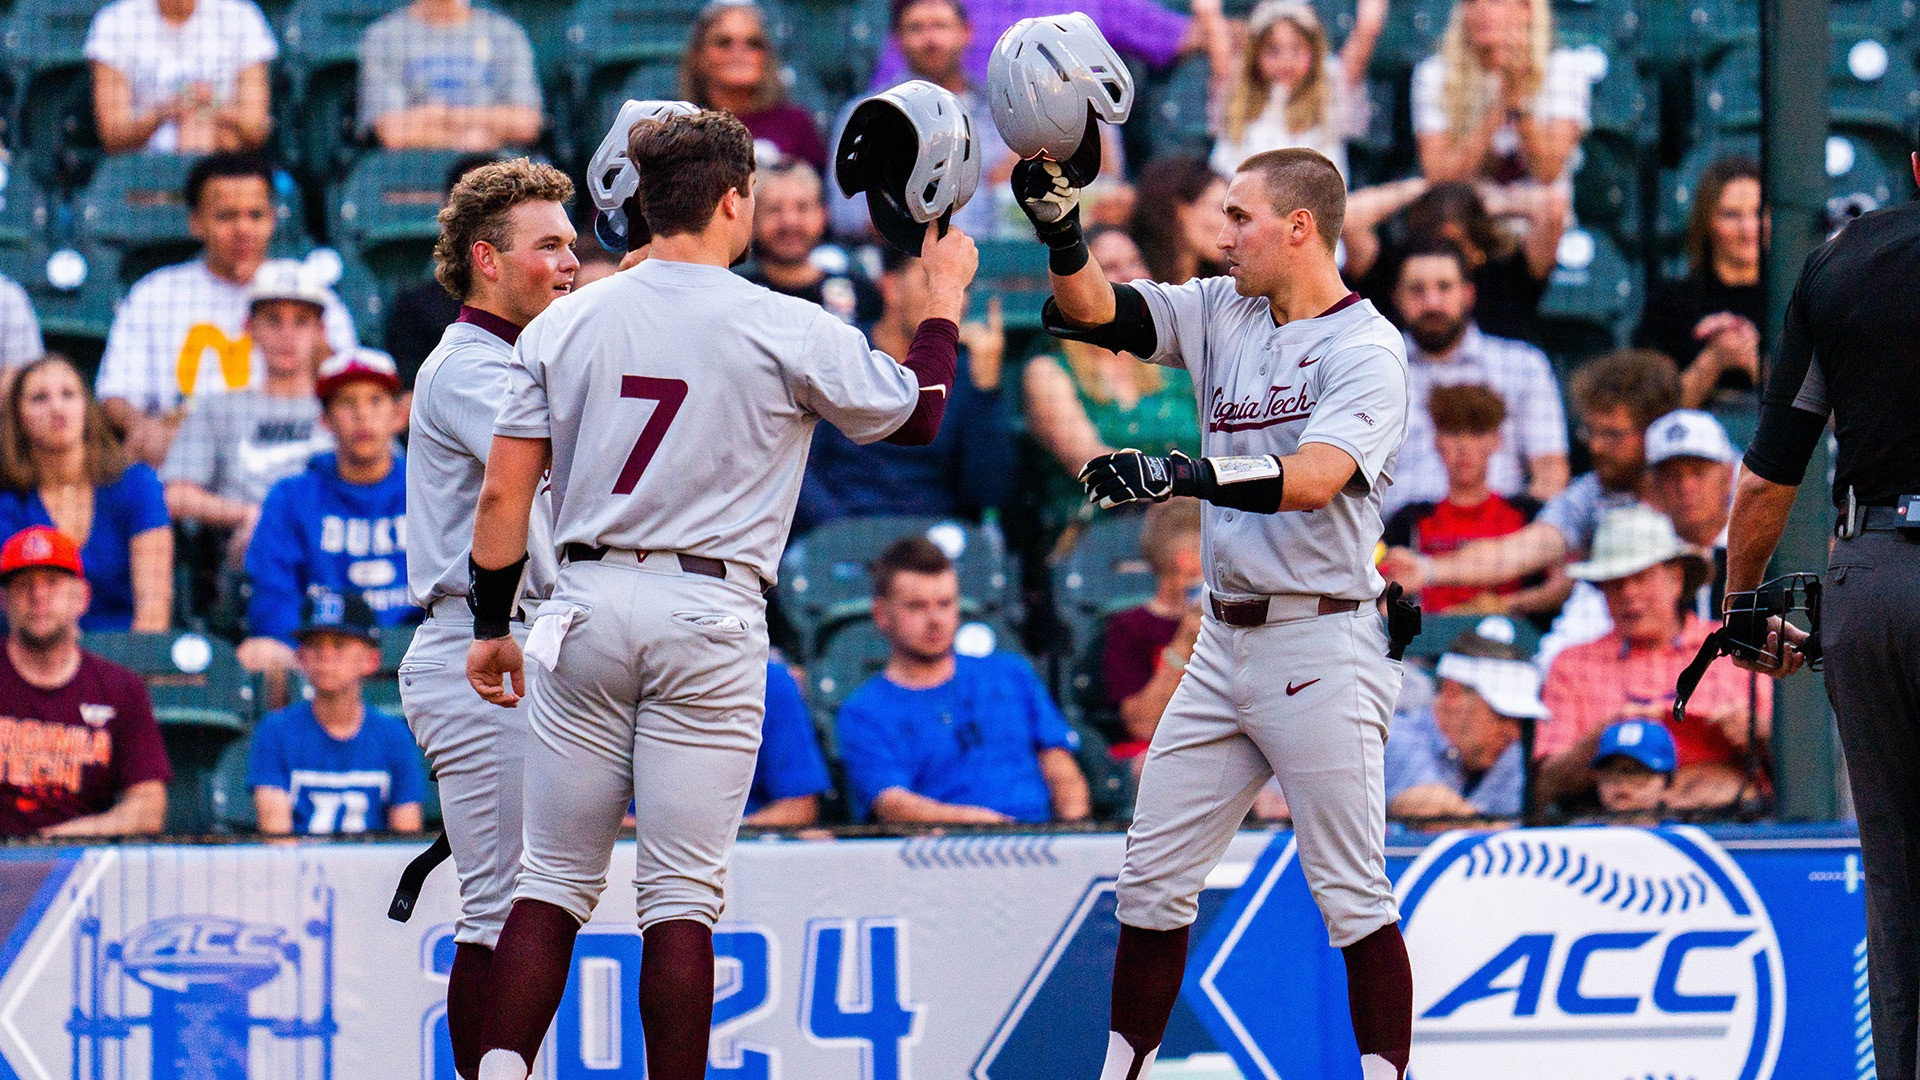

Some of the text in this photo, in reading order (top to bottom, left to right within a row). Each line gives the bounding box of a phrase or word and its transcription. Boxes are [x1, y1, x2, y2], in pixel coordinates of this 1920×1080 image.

[611, 374, 689, 495] 7
[1263, 382, 1316, 418] Tech
[1353, 412, 1375, 427] ACC
[423, 917, 925, 1080] 024
[1419, 928, 1760, 1018] ACC
